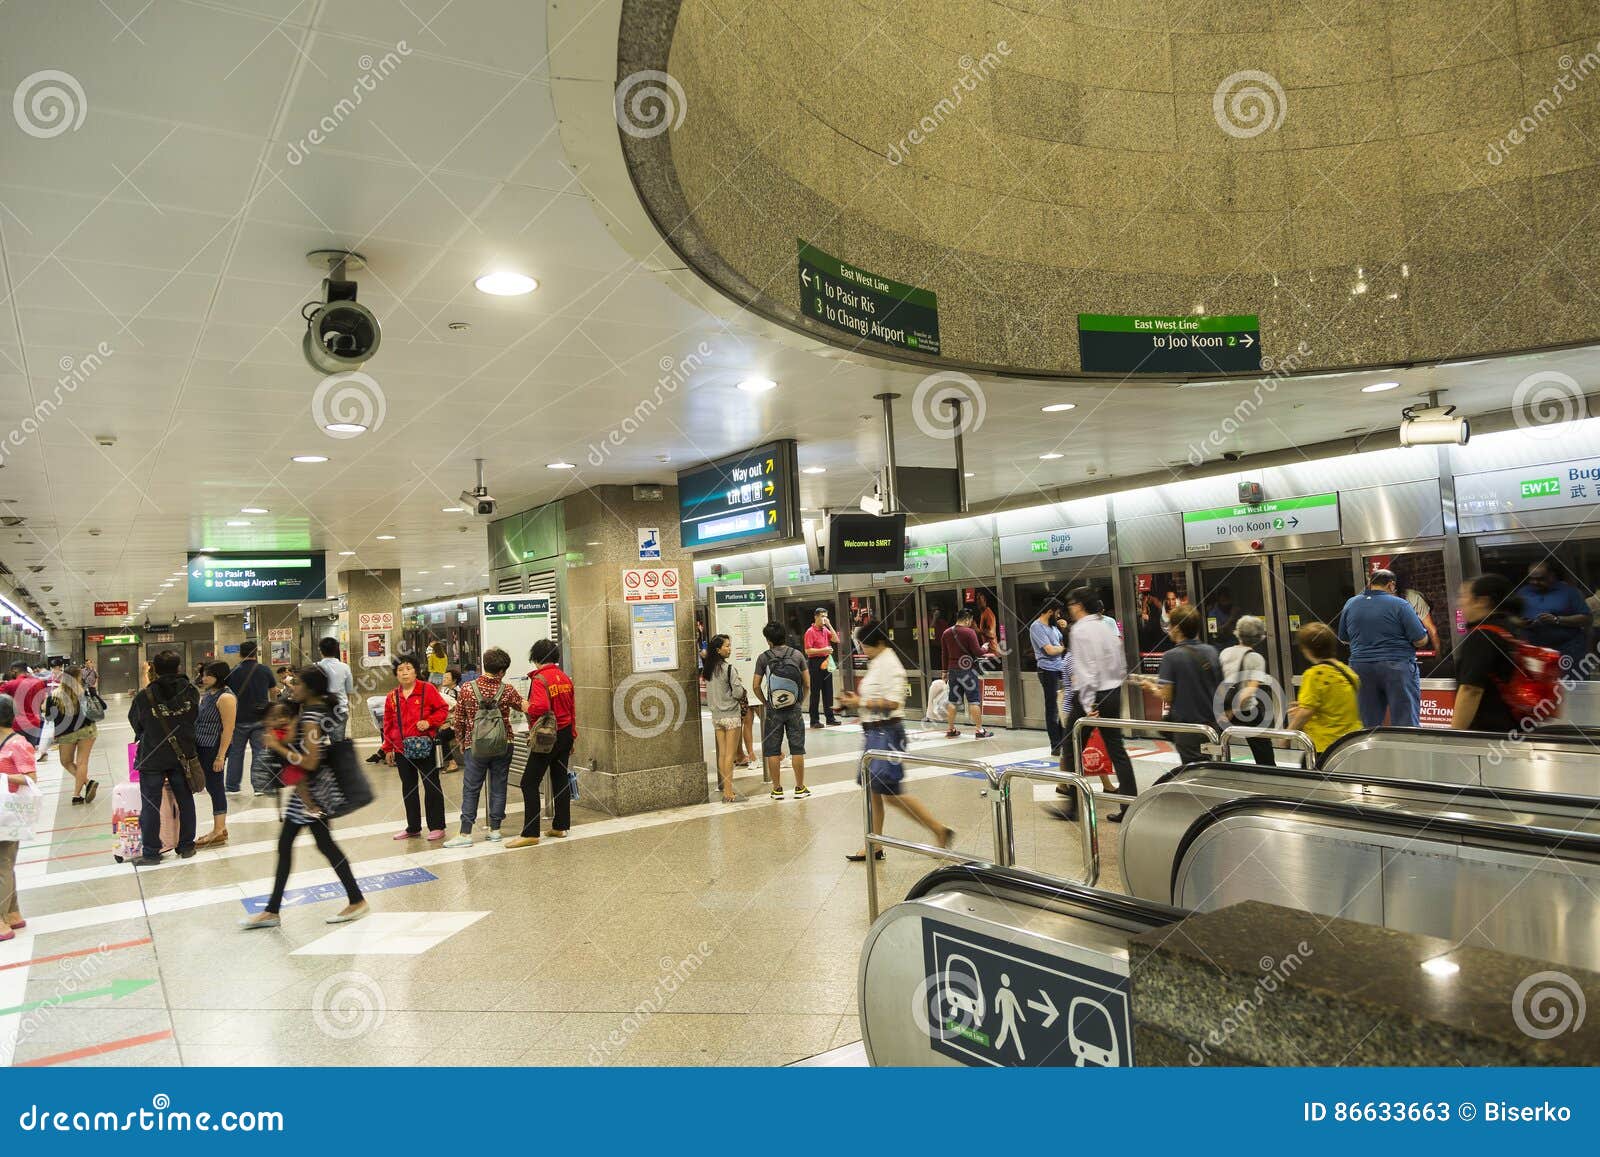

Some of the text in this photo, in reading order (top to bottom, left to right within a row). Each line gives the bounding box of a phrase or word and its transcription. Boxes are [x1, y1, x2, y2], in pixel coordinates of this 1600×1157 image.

[840, 264, 889, 293] East West Line
[814, 275, 876, 314] 1 to Pasir Ris
[816, 298, 823, 313] 3
[826, 305, 836, 321] to
[837, 309, 869, 336] Changi
[871, 321, 905, 343] Airport
[1134, 319, 1199, 330] East West Line
[1153, 336, 1166, 348] to
[1168, 335, 1188, 350] Joo
[1191, 335, 1223, 347] Koon
[732, 462, 763, 482] Way out
[1521, 481, 1559, 495] EW12
[1246, 505, 1263, 514] West
[1263, 503, 1278, 512] Line
[1217, 526, 1226, 535] to
[1228, 523, 1244, 536] Joo
[1246, 521, 1271, 532] Koon
[844, 540, 868, 548] Welcome
[875, 539, 892, 547] SMRT
[1031, 532, 1071, 551] EW12 Bugis
[215, 570, 223, 578] to
[224, 569, 243, 578] Pasir
[215, 579, 223, 587] to
[224, 579, 250, 588] Changi
[251, 579, 277, 588] Airport
[1420, 700, 1437, 708] GIS
[1420, 707, 1454, 716] NCTION
